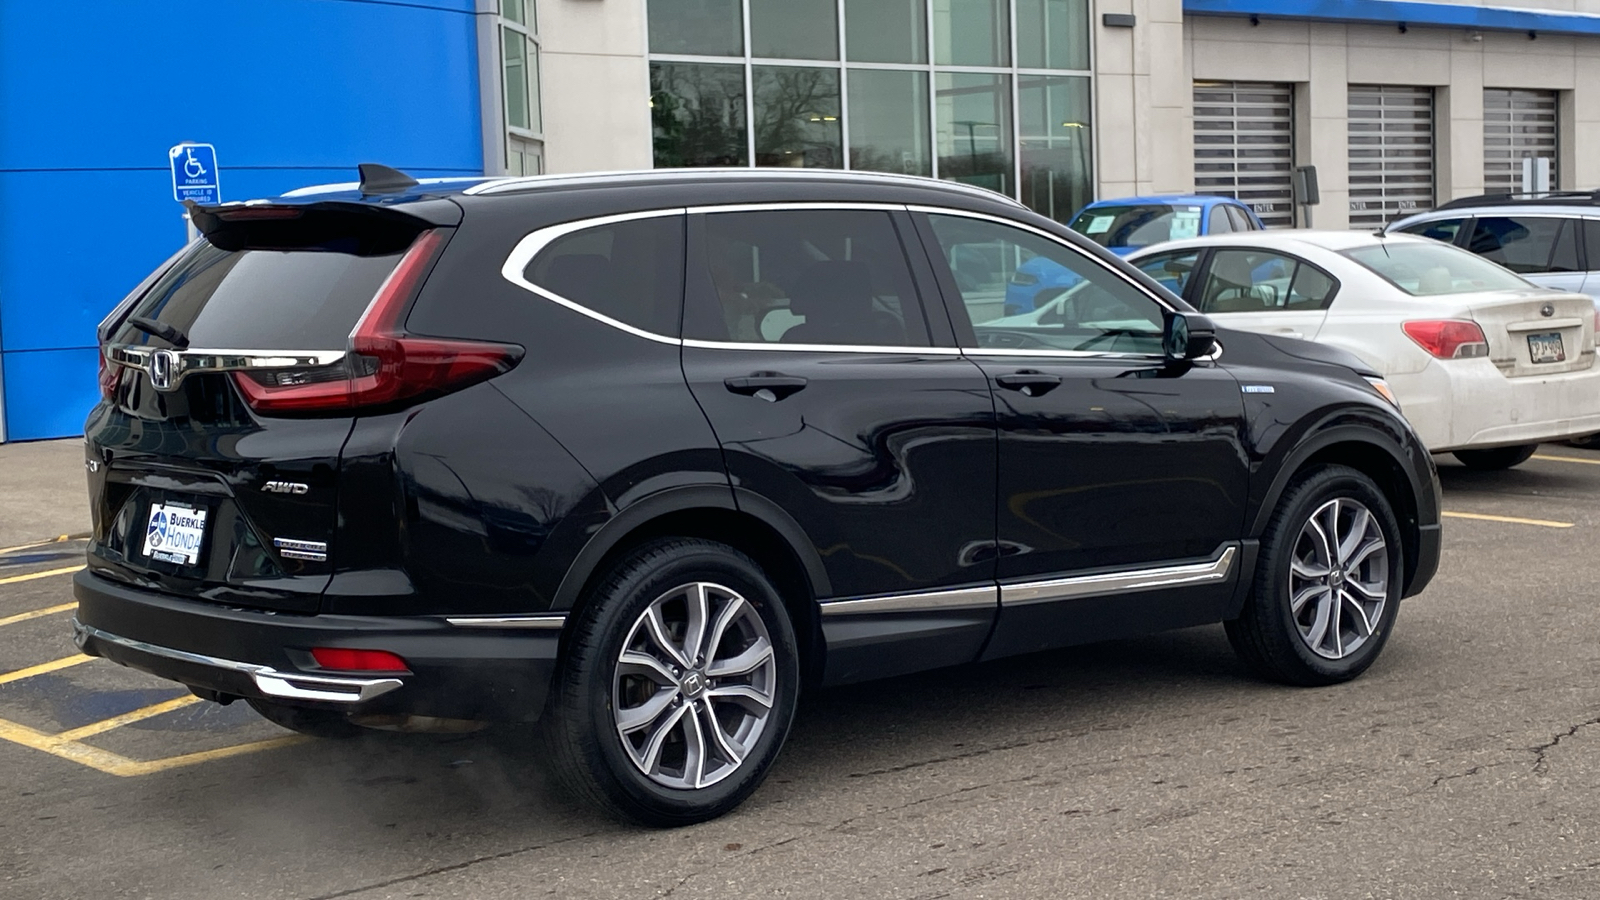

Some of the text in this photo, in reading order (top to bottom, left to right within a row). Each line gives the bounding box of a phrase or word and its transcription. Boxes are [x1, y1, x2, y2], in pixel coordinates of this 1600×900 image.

[260, 481, 309, 495] AWD
[170, 513, 205, 530] BUERKLE
[166, 526, 201, 550] HONDA
